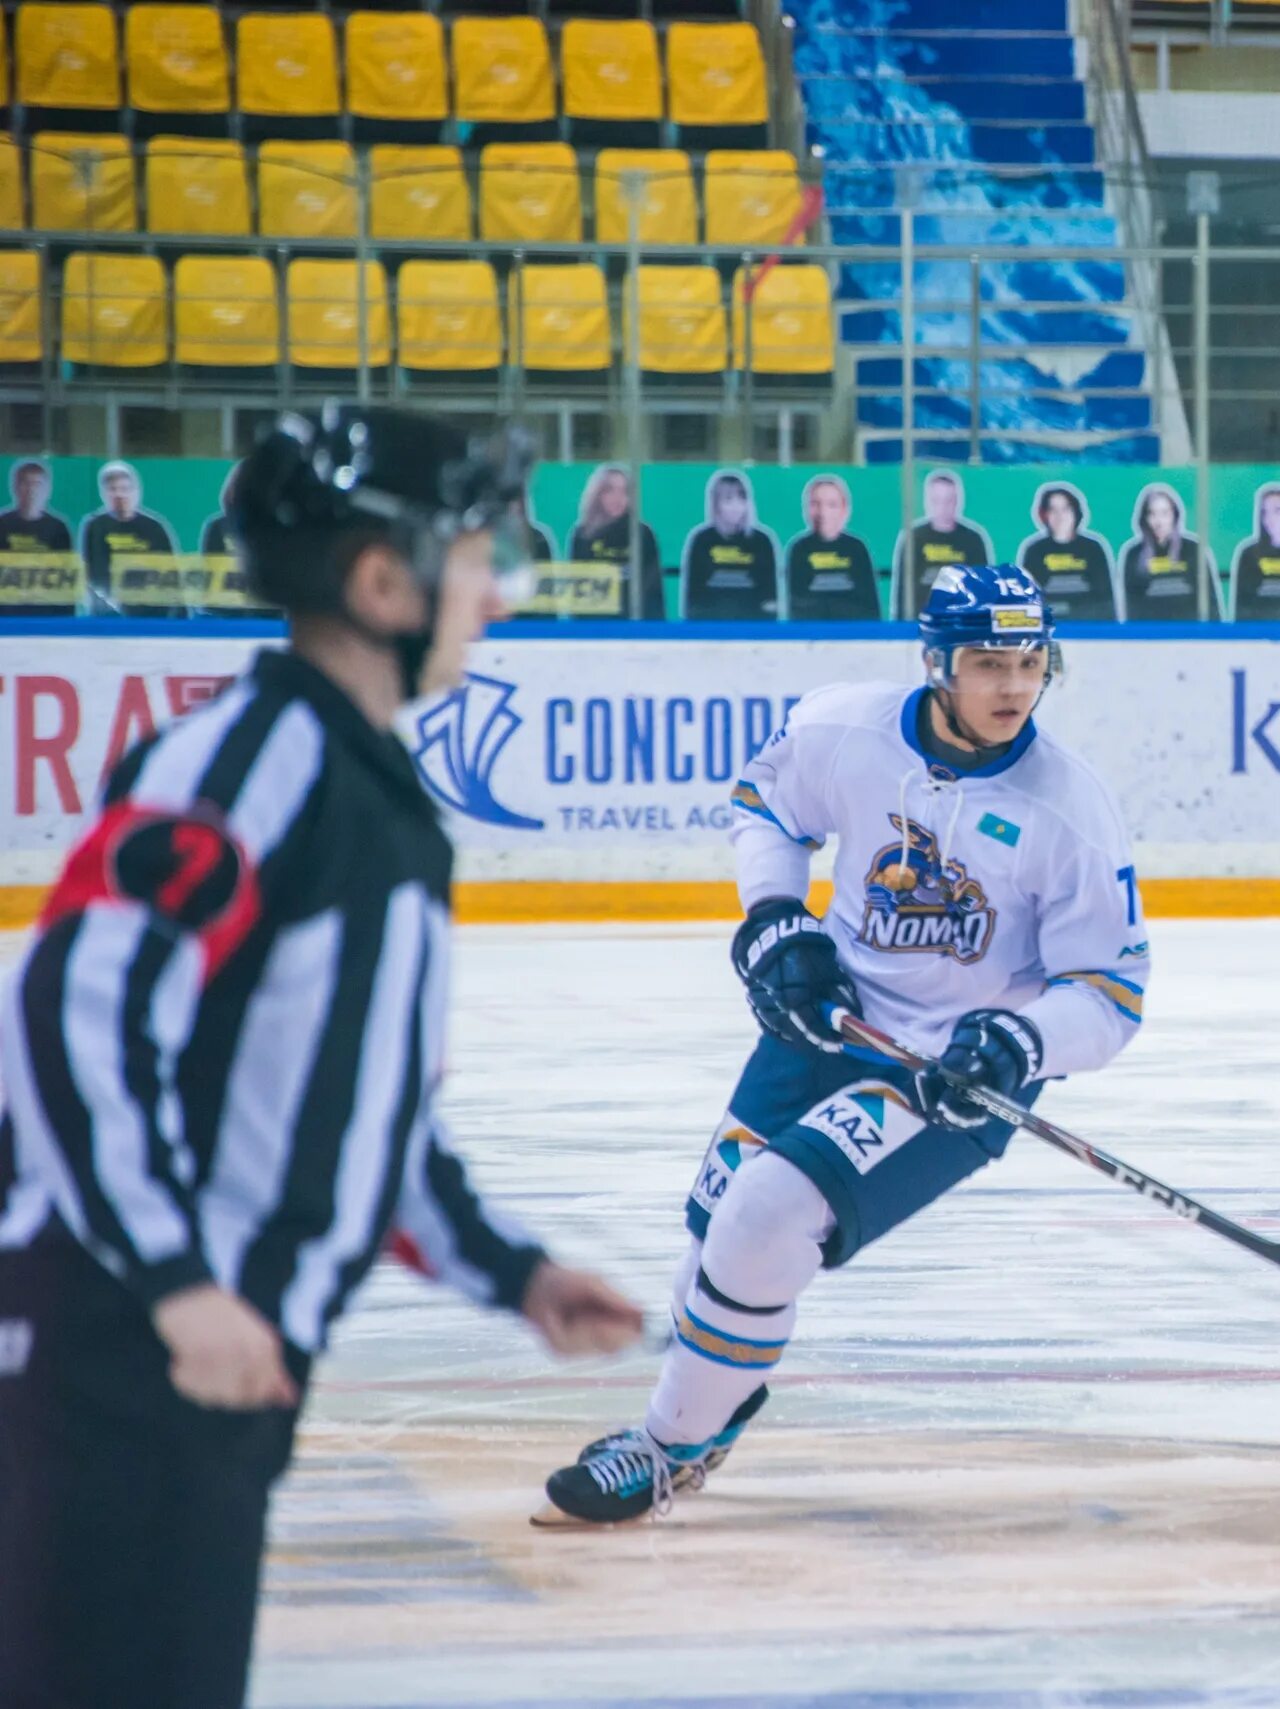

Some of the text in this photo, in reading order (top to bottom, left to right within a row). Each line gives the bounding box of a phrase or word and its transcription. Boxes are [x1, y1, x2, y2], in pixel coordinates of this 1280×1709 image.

[0, 567, 80, 591] ATCH
[545, 697, 801, 784] CONCOR
[558, 806, 673, 830] TRAVEL
[815, 1103, 885, 1158] KAZ
[700, 1162, 728, 1200] KA
[1112, 1167, 1201, 1223] CCM
